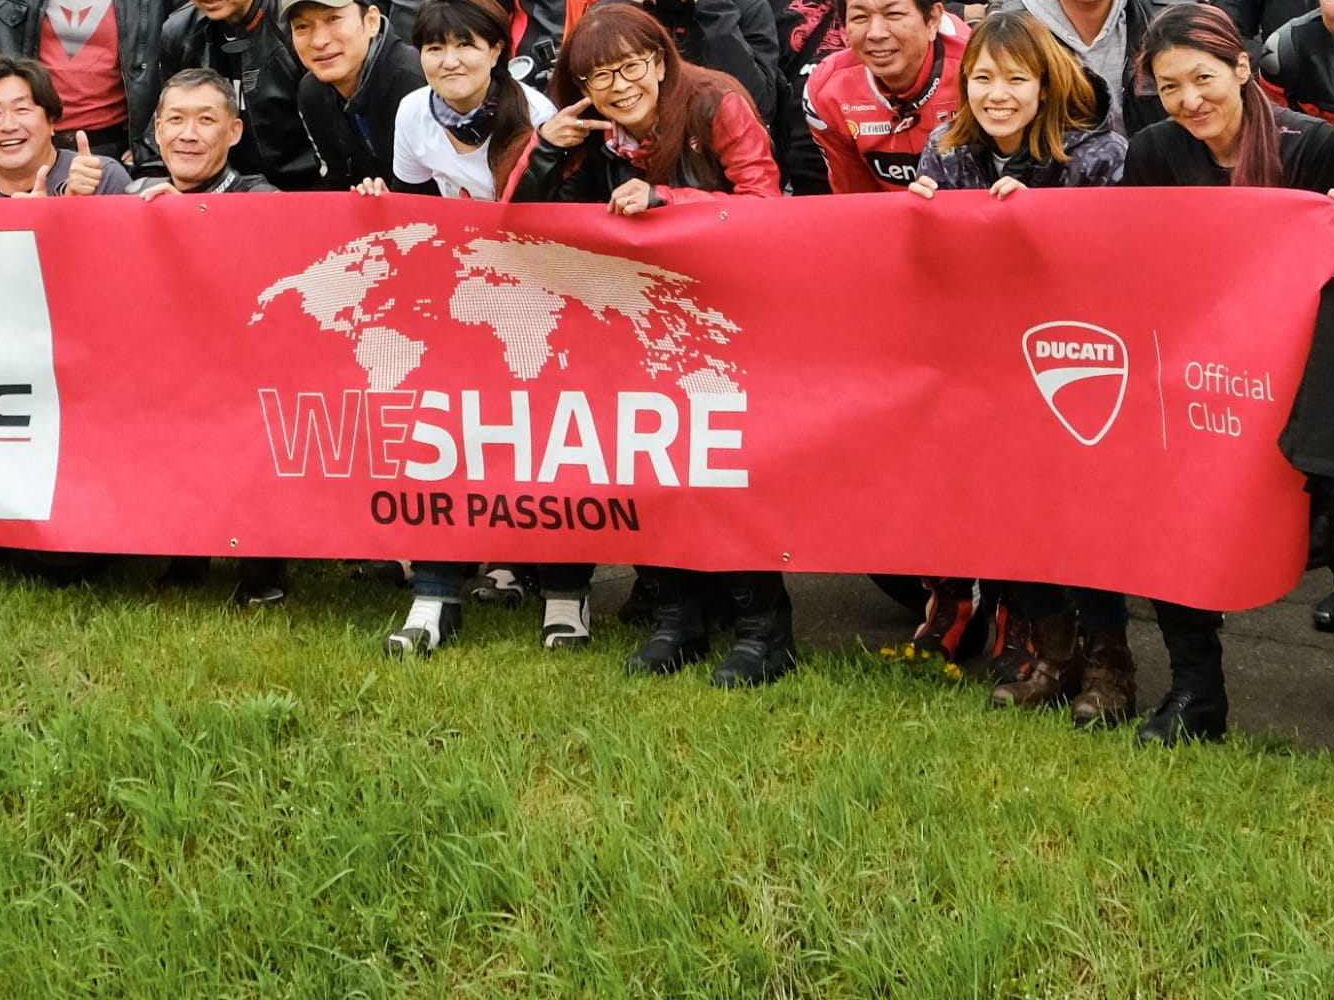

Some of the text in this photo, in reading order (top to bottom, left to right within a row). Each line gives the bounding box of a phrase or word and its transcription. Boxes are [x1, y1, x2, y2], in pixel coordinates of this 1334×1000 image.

[913, 77, 940, 109] Lenovo
[874, 159, 917, 180] Len
[1036, 341, 1114, 361] DUCATI
[1185, 361, 1275, 402] Official
[1188, 402, 1242, 437] Club
[404, 390, 749, 488] SHARE
[371, 490, 641, 532] OUR PASSION
